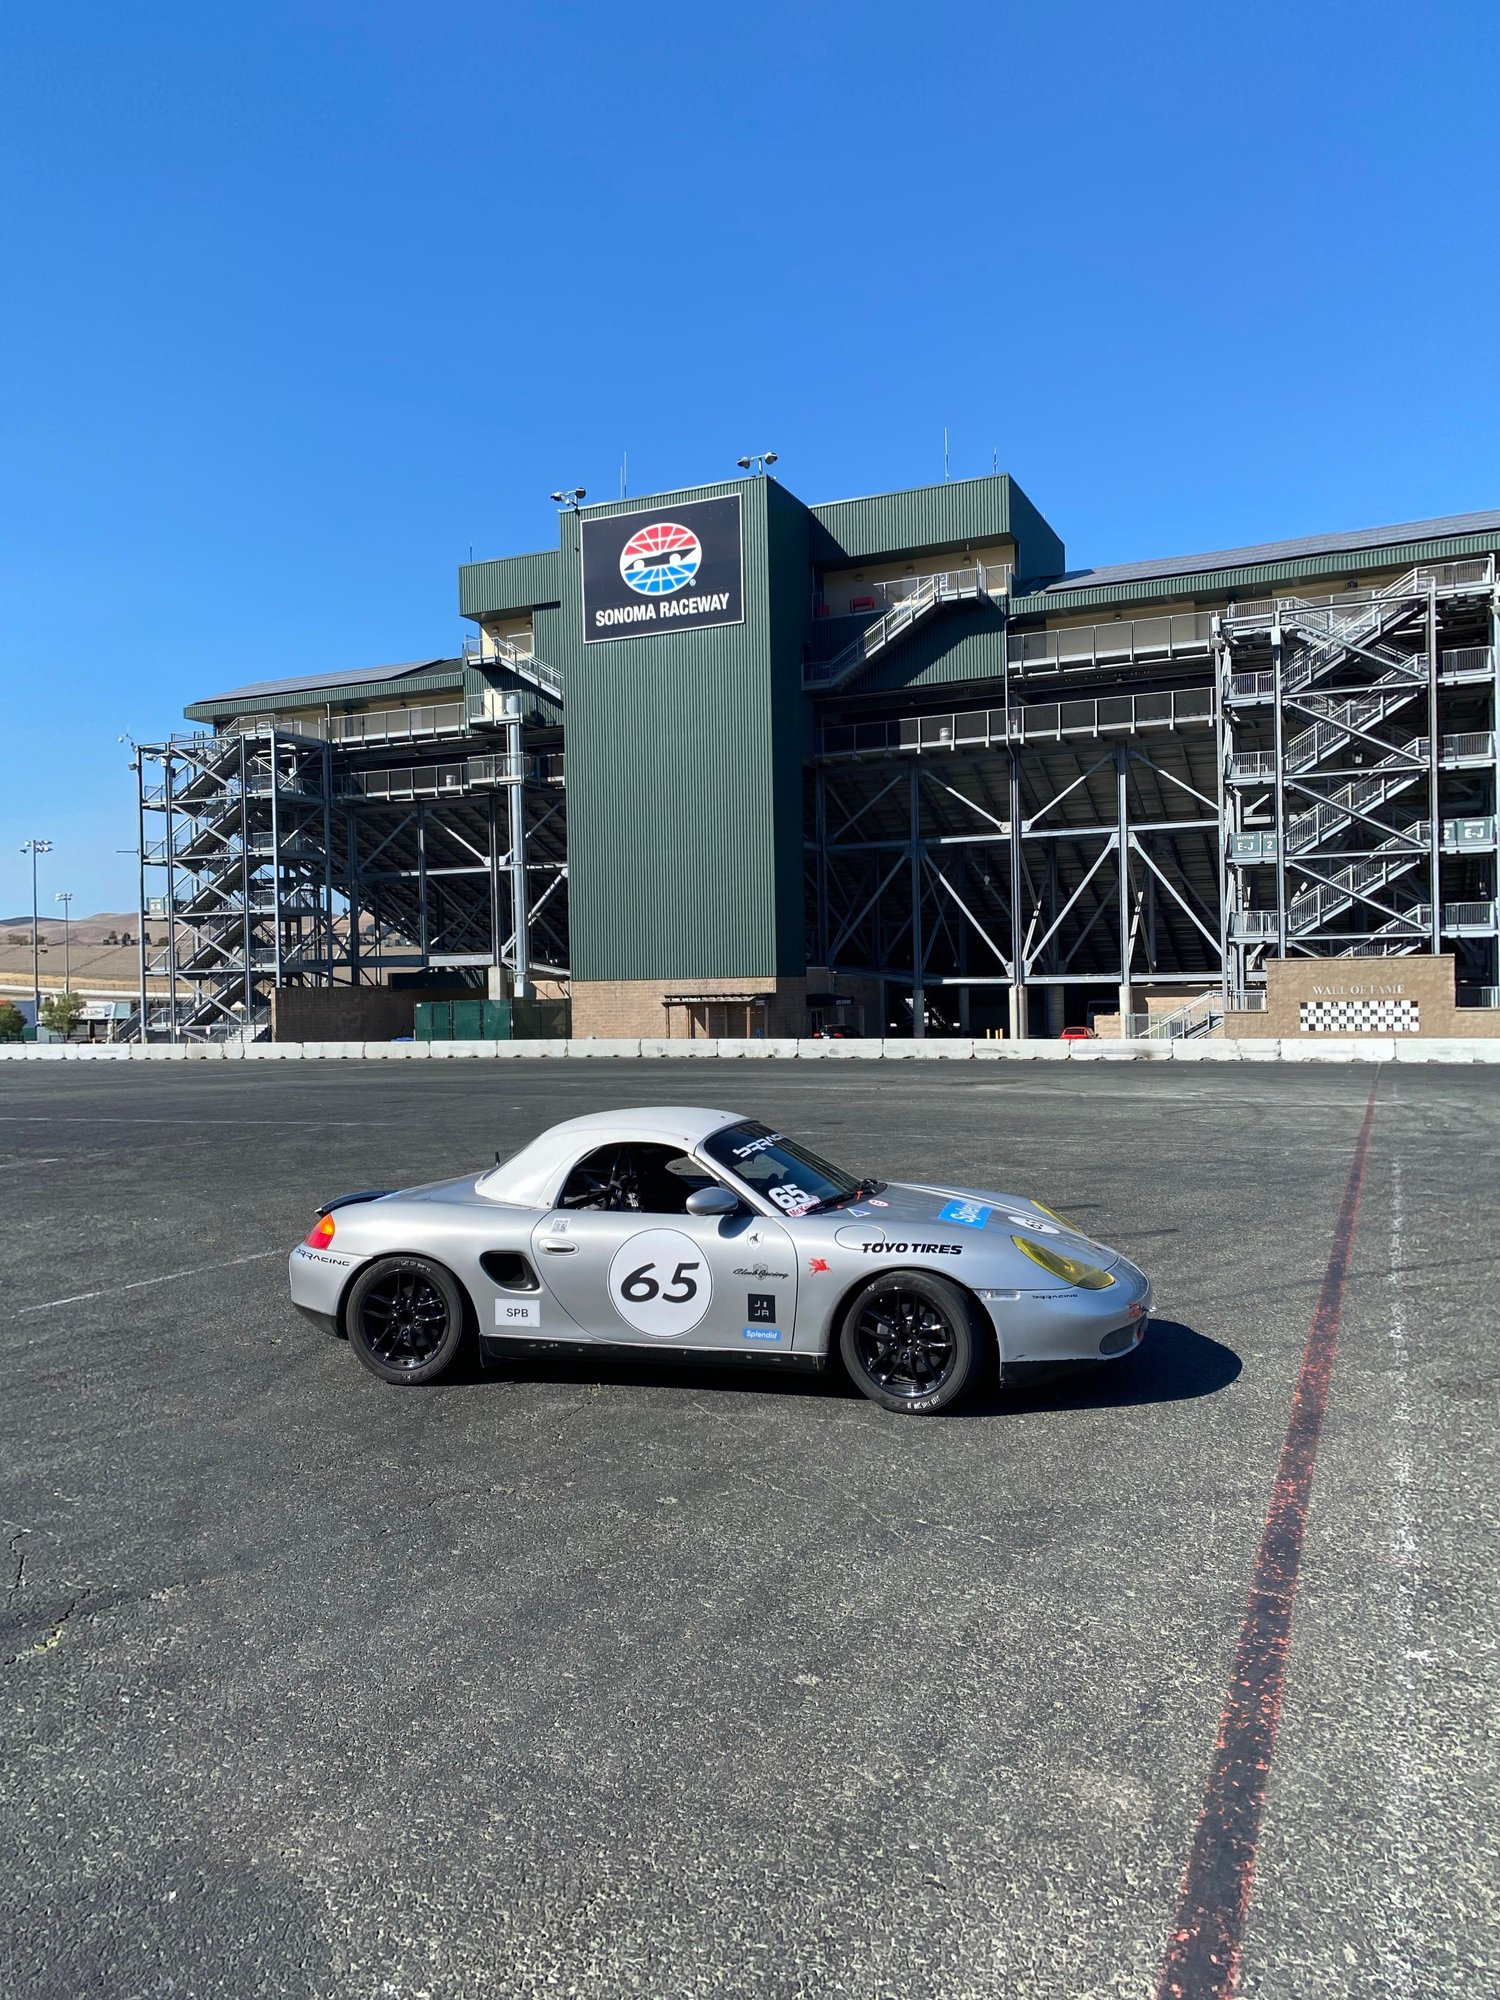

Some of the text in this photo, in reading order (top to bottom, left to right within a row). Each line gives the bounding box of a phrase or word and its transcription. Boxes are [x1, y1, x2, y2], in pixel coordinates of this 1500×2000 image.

[595, 593, 730, 627] SONOMA RACEWAY
[1464, 828, 1484, 839] E-J
[1237, 842, 1254, 851] E-J
[1266, 840, 1273, 850] 2
[1312, 984, 1405, 995] WALL OF FAME
[768, 1183, 811, 1209] 65
[862, 1243, 963, 1255] TOYO TIRES
[620, 1262, 700, 1304] 65
[506, 1308, 529, 1318] SPB
[746, 1329, 777, 1339] Splendid
